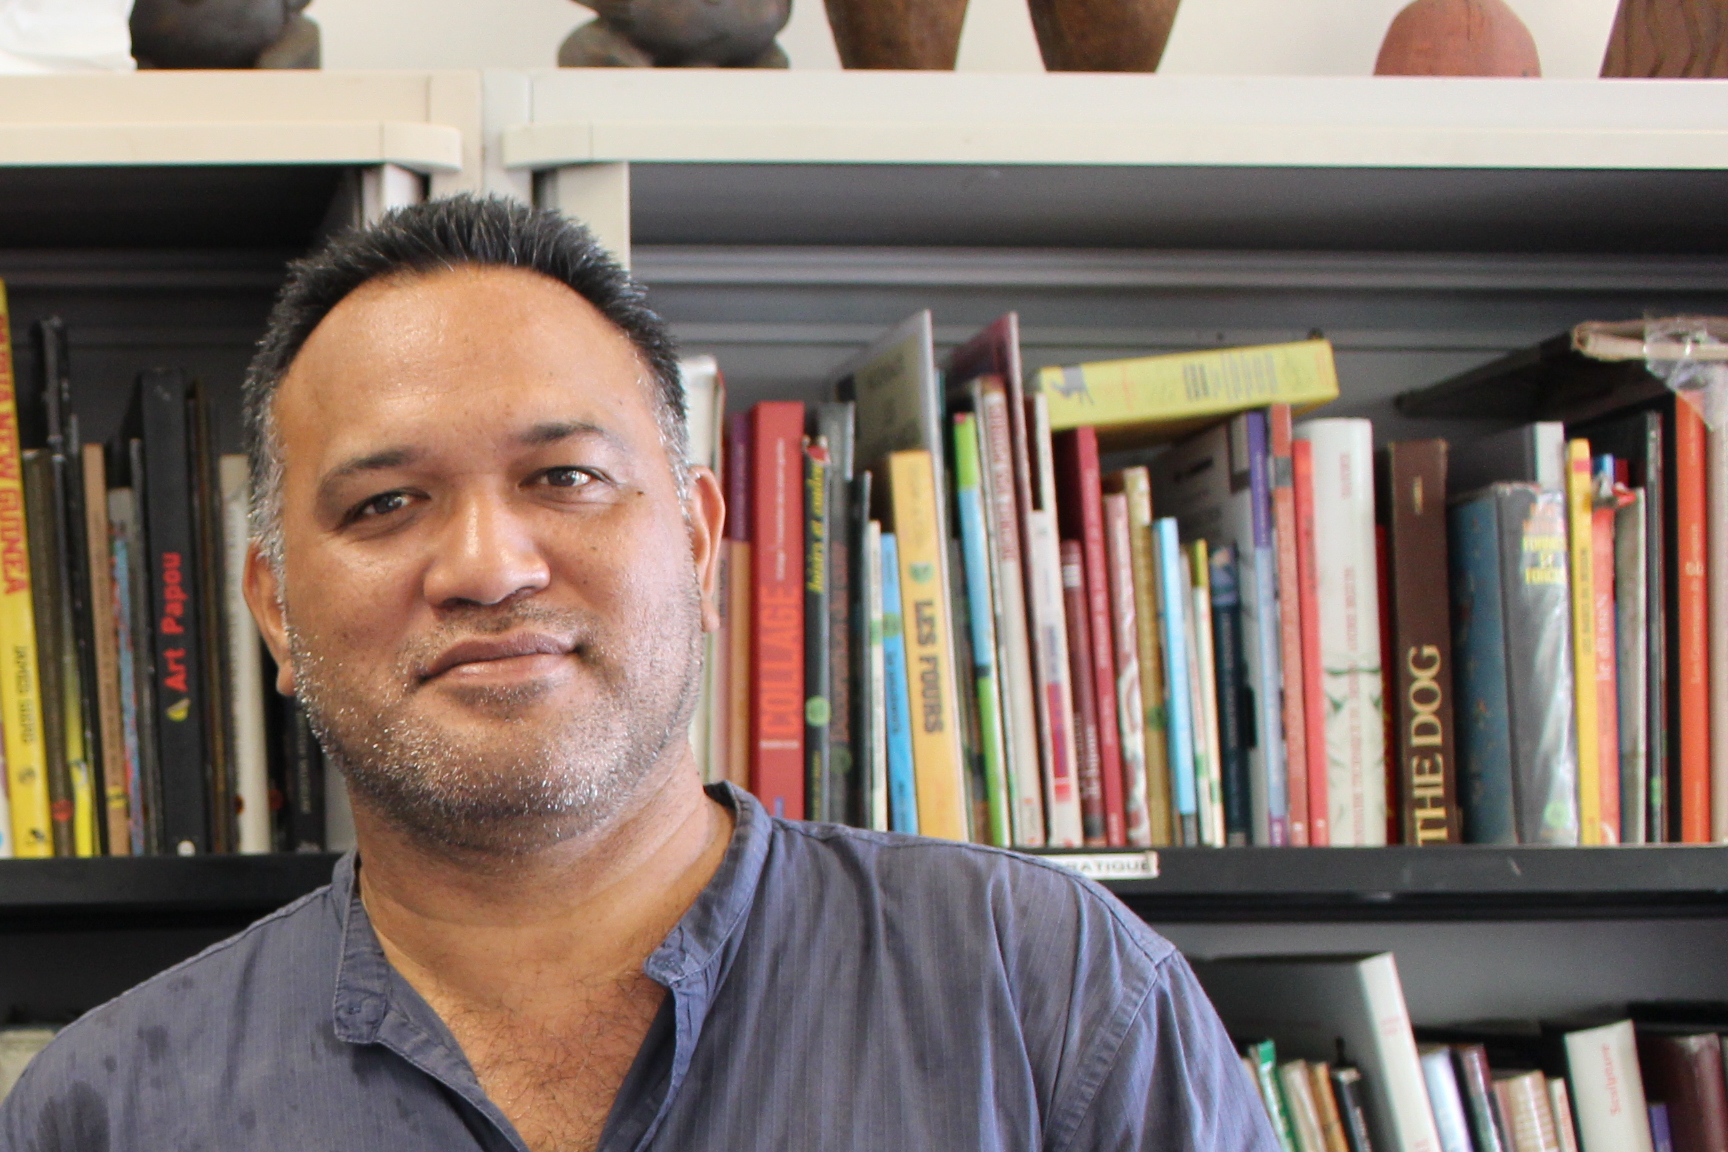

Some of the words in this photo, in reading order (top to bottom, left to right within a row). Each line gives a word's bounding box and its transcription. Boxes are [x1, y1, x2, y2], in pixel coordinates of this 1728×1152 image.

[160, 553, 187, 634] Papou
[914, 600, 935, 646] LES
[163, 648, 188, 692] Art
[760, 584, 800, 735] COLLAGE
[920, 656, 943, 734] FOURS
[1407, 644, 1443, 747] DOG
[1410, 753, 1448, 846] THE
